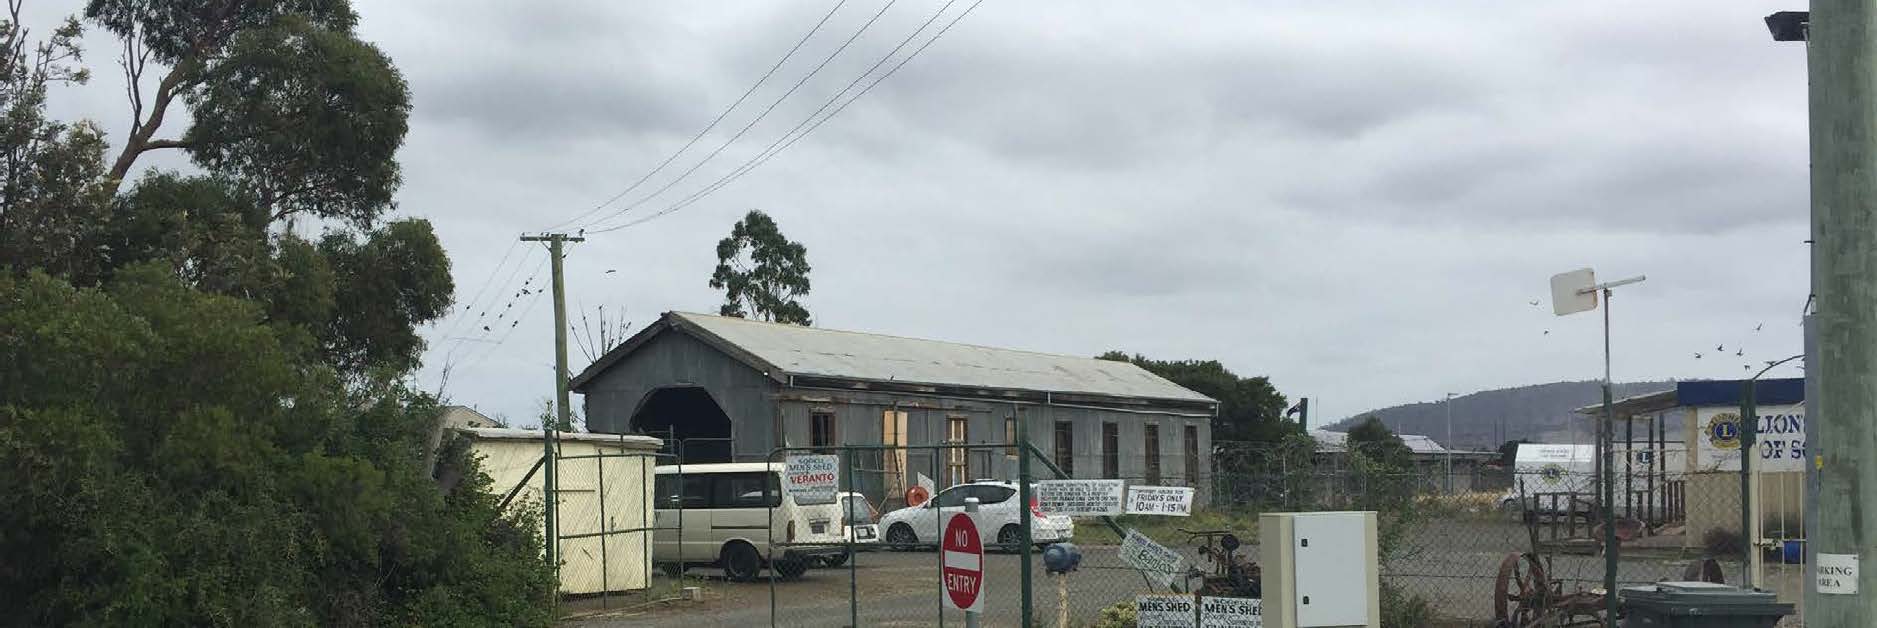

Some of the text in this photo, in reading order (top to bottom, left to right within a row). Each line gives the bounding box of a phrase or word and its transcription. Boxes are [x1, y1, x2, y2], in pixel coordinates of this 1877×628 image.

[1756, 414, 1805, 434] LION
[1762, 440, 1806, 459] OF S
[790, 473, 835, 484] VERANTO
[1136, 494, 1184, 503] FRIDAYS ONLY
[955, 529, 968, 548] NO
[947, 573, 977, 594] ENTRY
[1166, 602, 1191, 613] SHED
